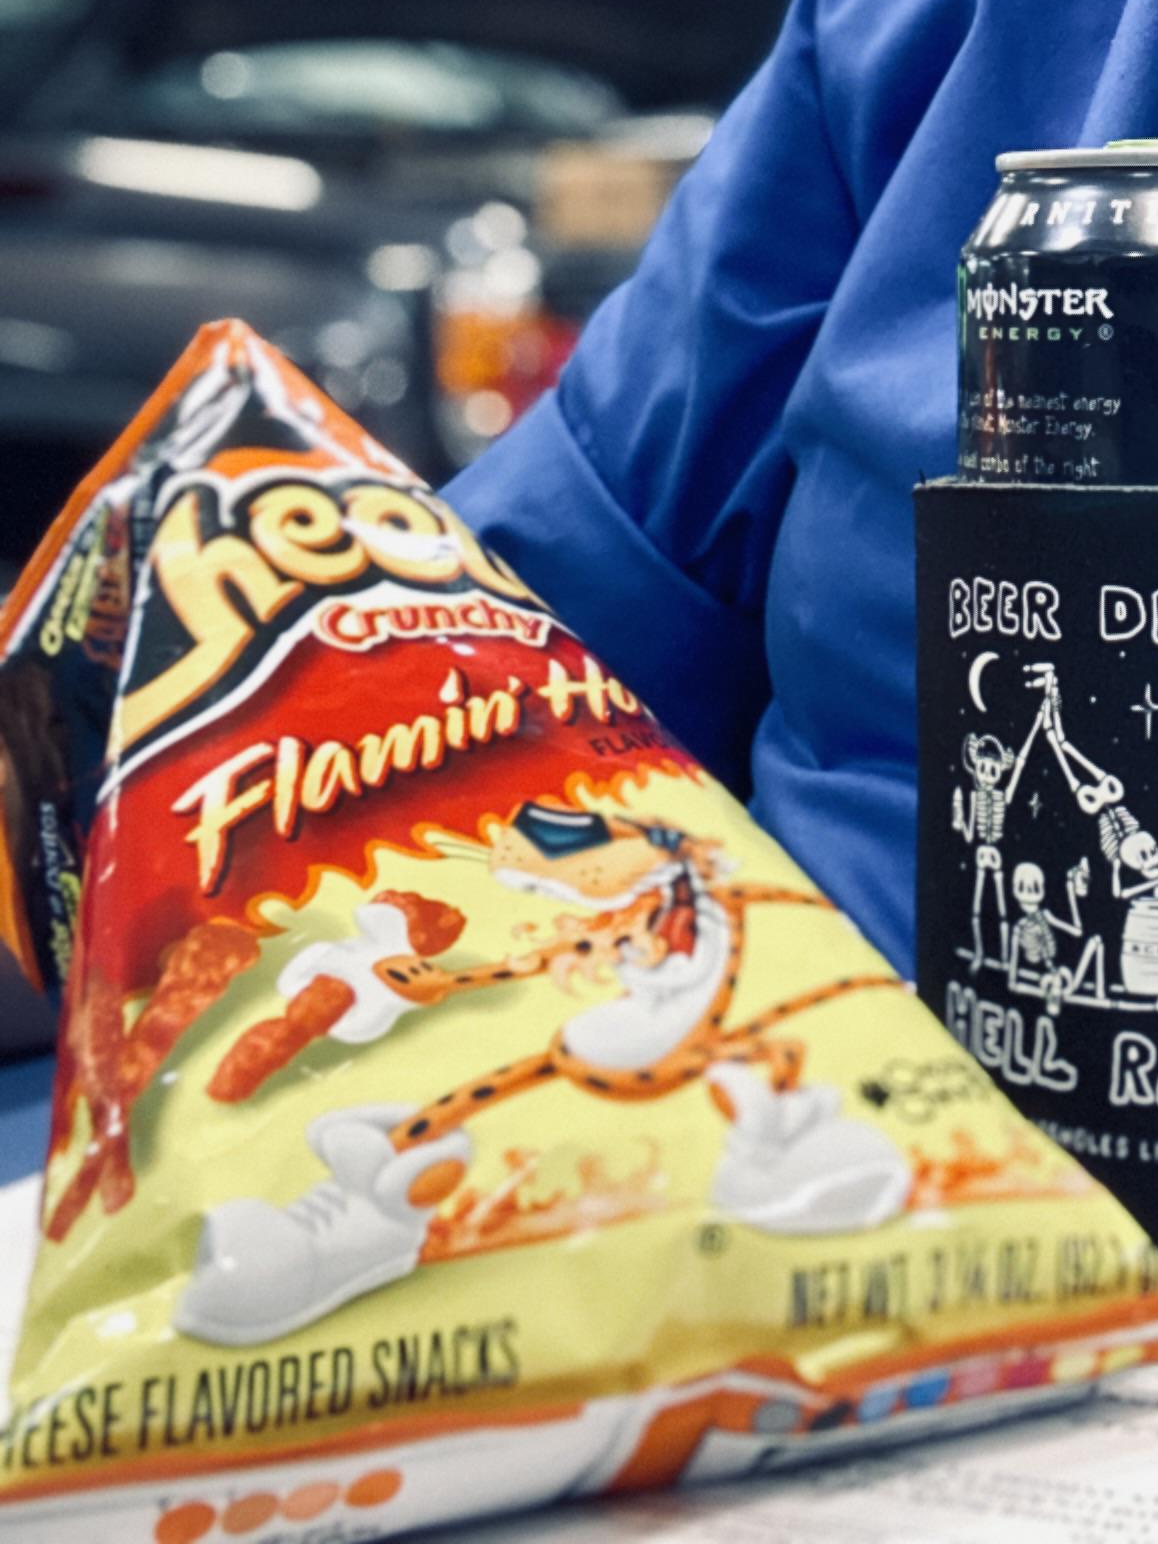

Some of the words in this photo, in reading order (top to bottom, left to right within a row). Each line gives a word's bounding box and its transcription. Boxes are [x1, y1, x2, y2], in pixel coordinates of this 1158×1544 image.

[966, 281, 1115, 322] MONSTER
[978, 326, 1084, 341] ENERGY
[1072, 395, 1121, 416] energy
[1062, 457, 1101, 481] right
[318, 600, 549, 650] Crunchy
[949, 577, 1062, 641] BEER
[536, 653, 641, 722] Ho
[946, 979, 1079, 1092] HELL
[138, 1346, 354, 1451] FLAVORED
[368, 1316, 519, 1410] SNACKS
